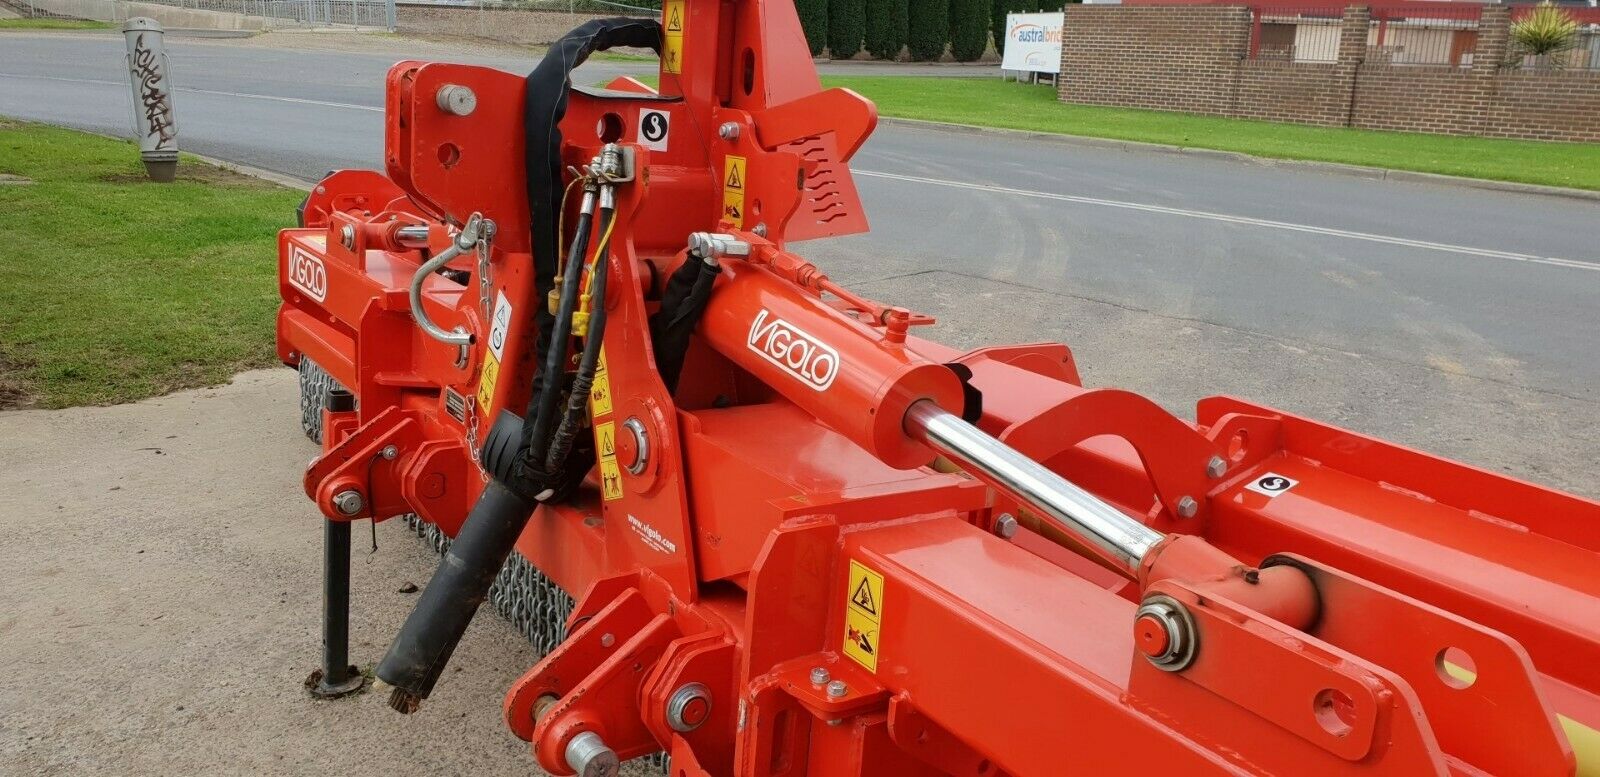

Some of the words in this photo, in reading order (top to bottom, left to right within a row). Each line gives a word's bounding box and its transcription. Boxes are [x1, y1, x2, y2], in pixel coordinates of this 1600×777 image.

[288, 242, 326, 301] VIGOLO
[747, 309, 838, 390] VIGOLO
[627, 513, 676, 552] www.vigolo.com
